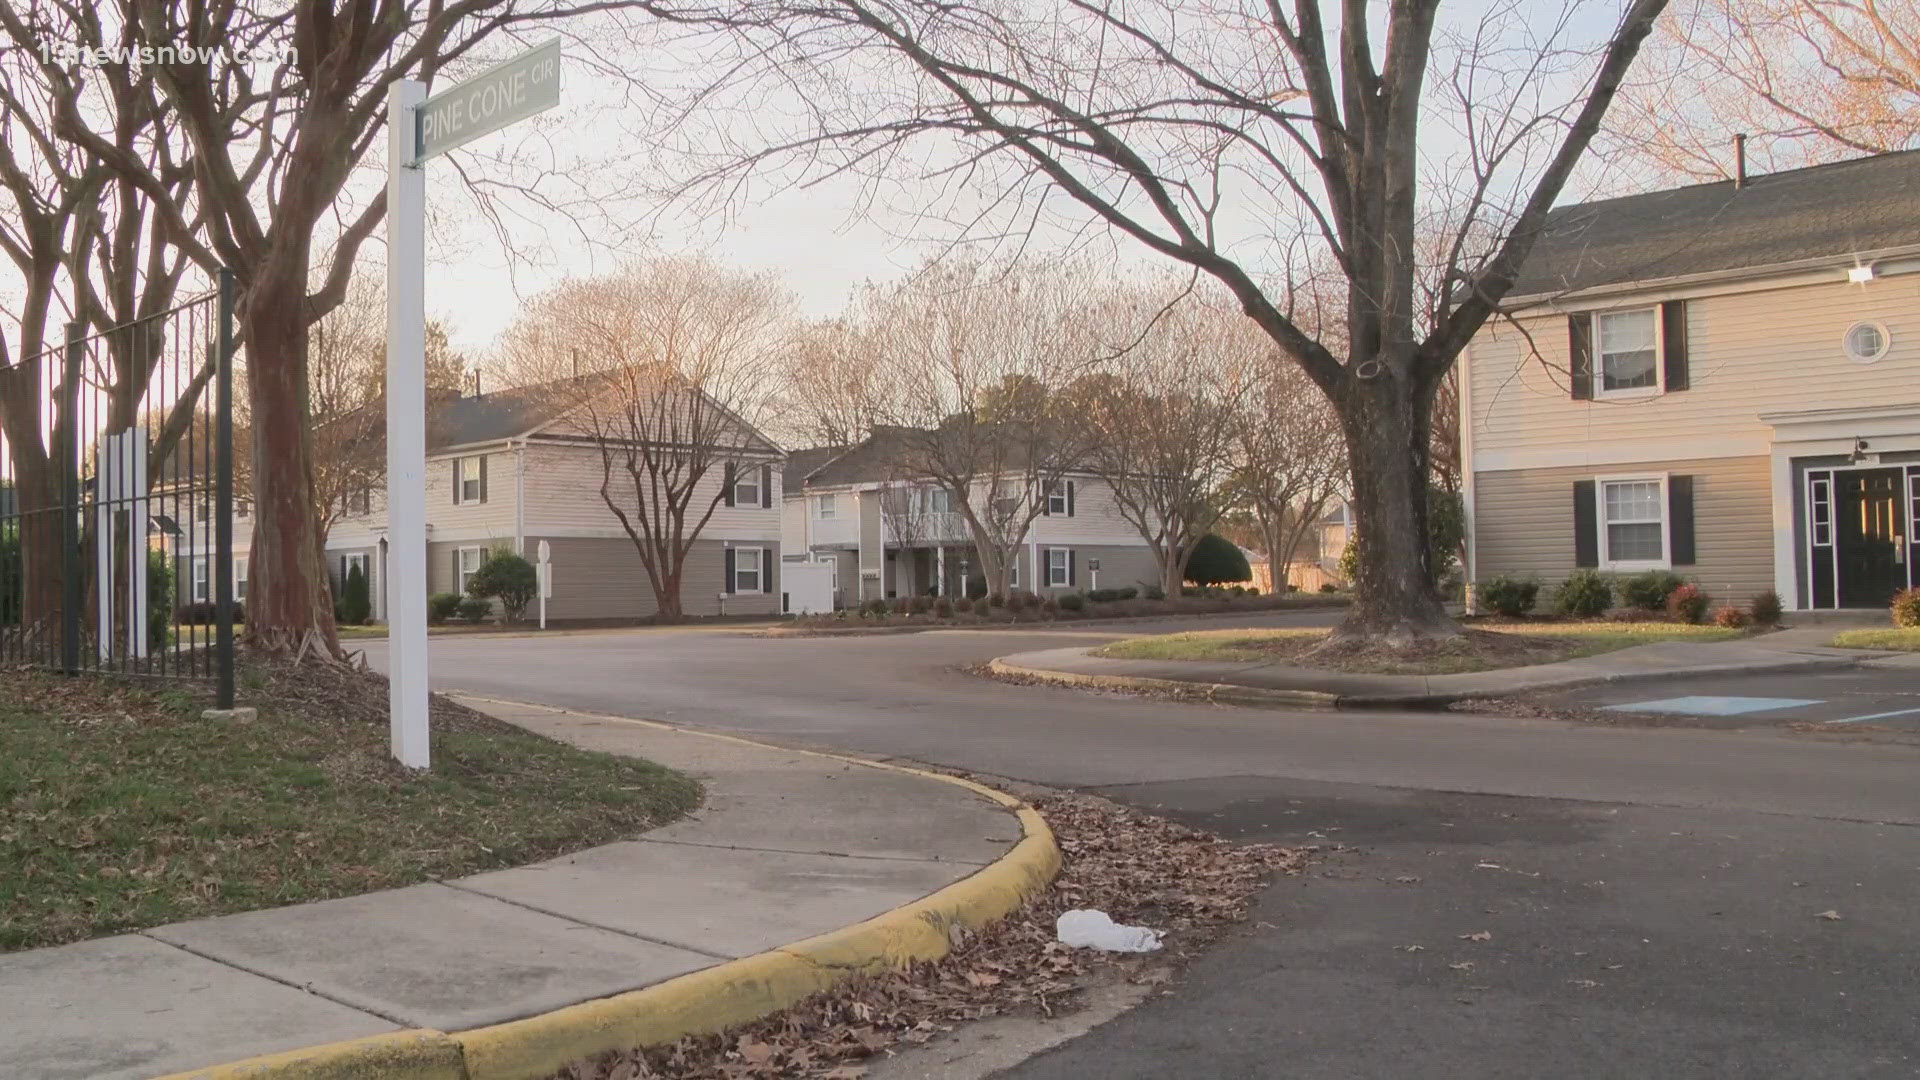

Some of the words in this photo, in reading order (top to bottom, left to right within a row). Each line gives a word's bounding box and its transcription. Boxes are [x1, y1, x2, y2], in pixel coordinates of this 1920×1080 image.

[422, 100, 463, 145] PINE
[469, 70, 526, 123] CONE
[531, 58, 553, 84] CIR
